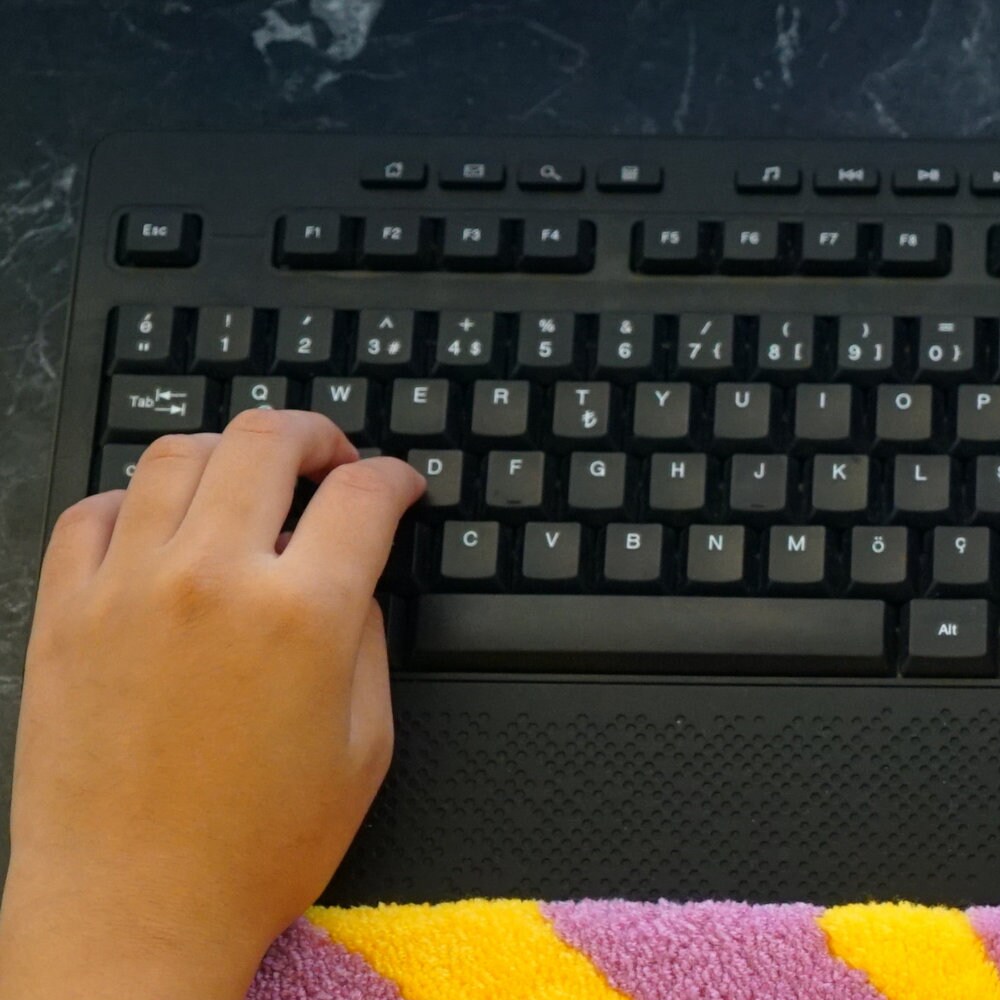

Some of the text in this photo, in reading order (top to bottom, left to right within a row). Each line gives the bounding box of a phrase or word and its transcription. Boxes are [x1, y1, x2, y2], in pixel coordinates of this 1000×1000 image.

[142, 223, 168, 237] Esc
[304, 225, 321, 238] F1
[382, 226, 402, 240] F2
[462, 227, 482, 242] F3
[541, 228, 560, 241] F4
[660, 230, 680, 245] F5
[740, 231, 760, 245] F6
[819, 231, 839, 245] F7
[899, 233, 918, 247] F8
[538, 318, 556, 333] %
[619, 319, 633, 335] &
[220, 336, 230, 353] 1
[297, 337, 313, 354] 2
[367, 338, 401, 355] 3 #
[447, 339, 482, 357] 4 $
[538, 340, 553, 358] 5
[617, 341, 633, 360] 6
[688, 342, 702, 360] 7
[767, 343, 781, 361] 8
[847, 343, 862, 361] 9
[251, 383, 269, 401] Q
[330, 384, 352, 403] W
[413, 386, 429, 404] E
[493, 387, 510, 405] R
[575, 388, 590, 406] T
[654, 390, 671, 407] Y
[734, 391, 750, 408] U
[819, 391, 826, 409] I
[129, 395, 155, 408] Tab
[894, 392, 912, 410] O
[976, 393, 992, 410] P
[426, 458, 443, 476] D
[509, 458, 523, 475] F
[589, 460, 606, 477] G
[670, 461, 686, 479] H
[753, 462, 766, 480] J
[832, 463, 847, 481] K
[914, 464, 928, 481] L
[462, 530, 479, 547] C
[545, 531, 560, 548] V
[625, 532, 641, 550] B
[708, 534, 724, 551] N
[787, 534, 806, 552] M
[937, 623, 958, 636] Alt
